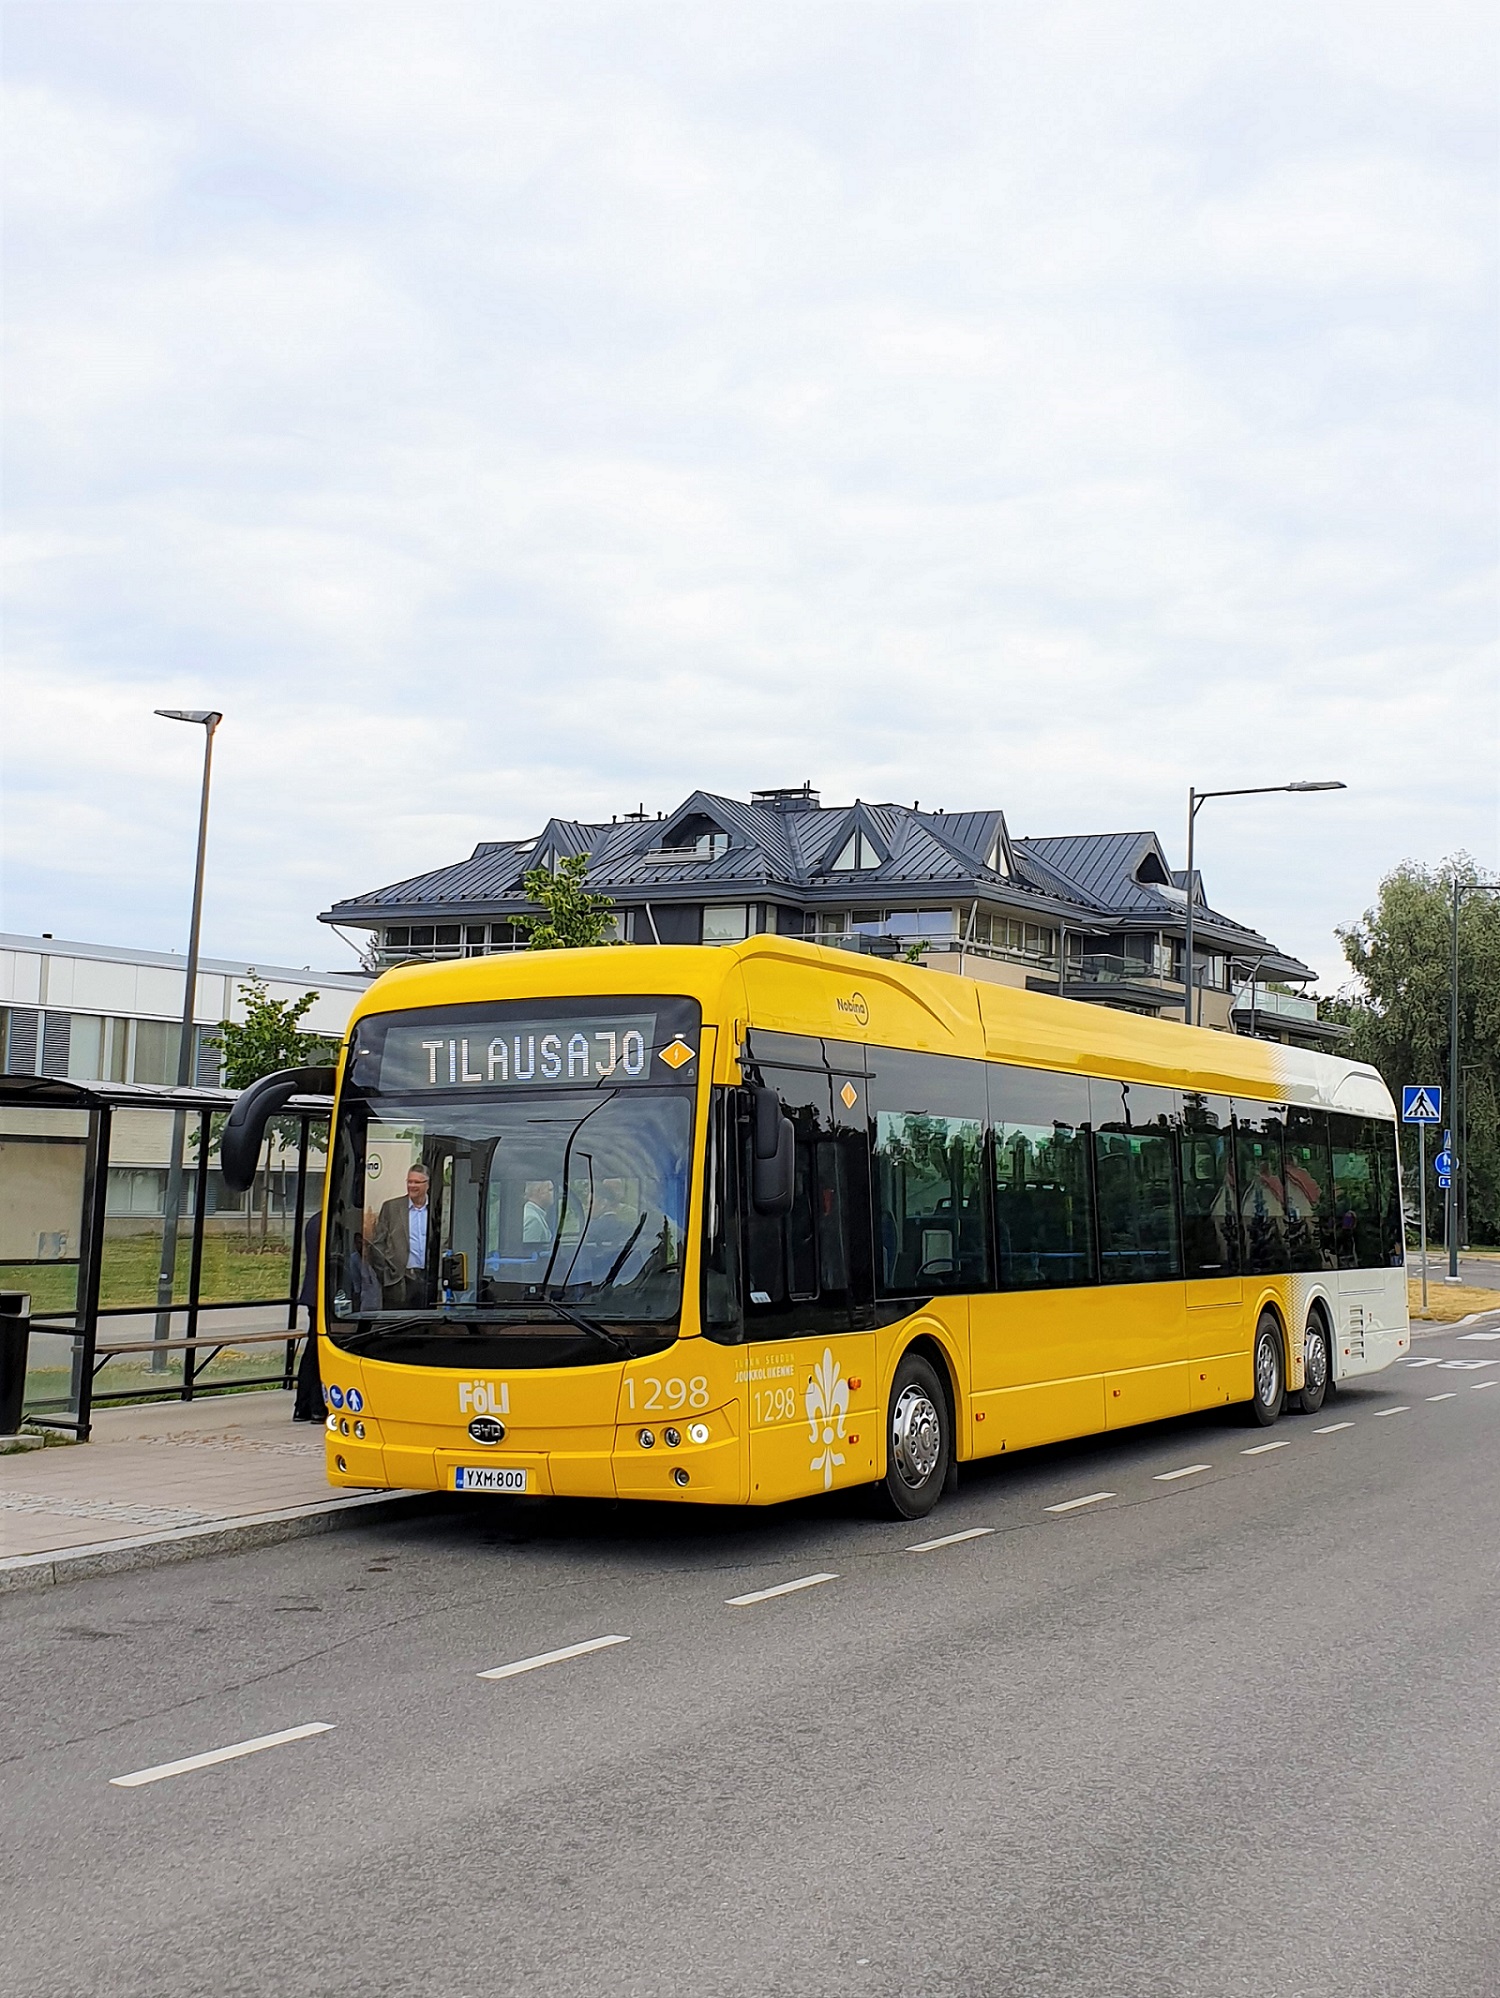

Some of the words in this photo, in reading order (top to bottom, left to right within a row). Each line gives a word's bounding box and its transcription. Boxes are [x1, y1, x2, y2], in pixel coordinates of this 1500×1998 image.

[836, 997, 865, 1014] Nobina
[421, 1030, 645, 1084] TILAUSAJO
[734, 1364, 795, 1383] JOUKKOLIIKENNE
[623, 1375, 710, 1411] 1298
[754, 1387, 796, 1423] 1298
[471, 1424, 501, 1437] BYD
[467, 1470, 523, 1488] YXM-800
